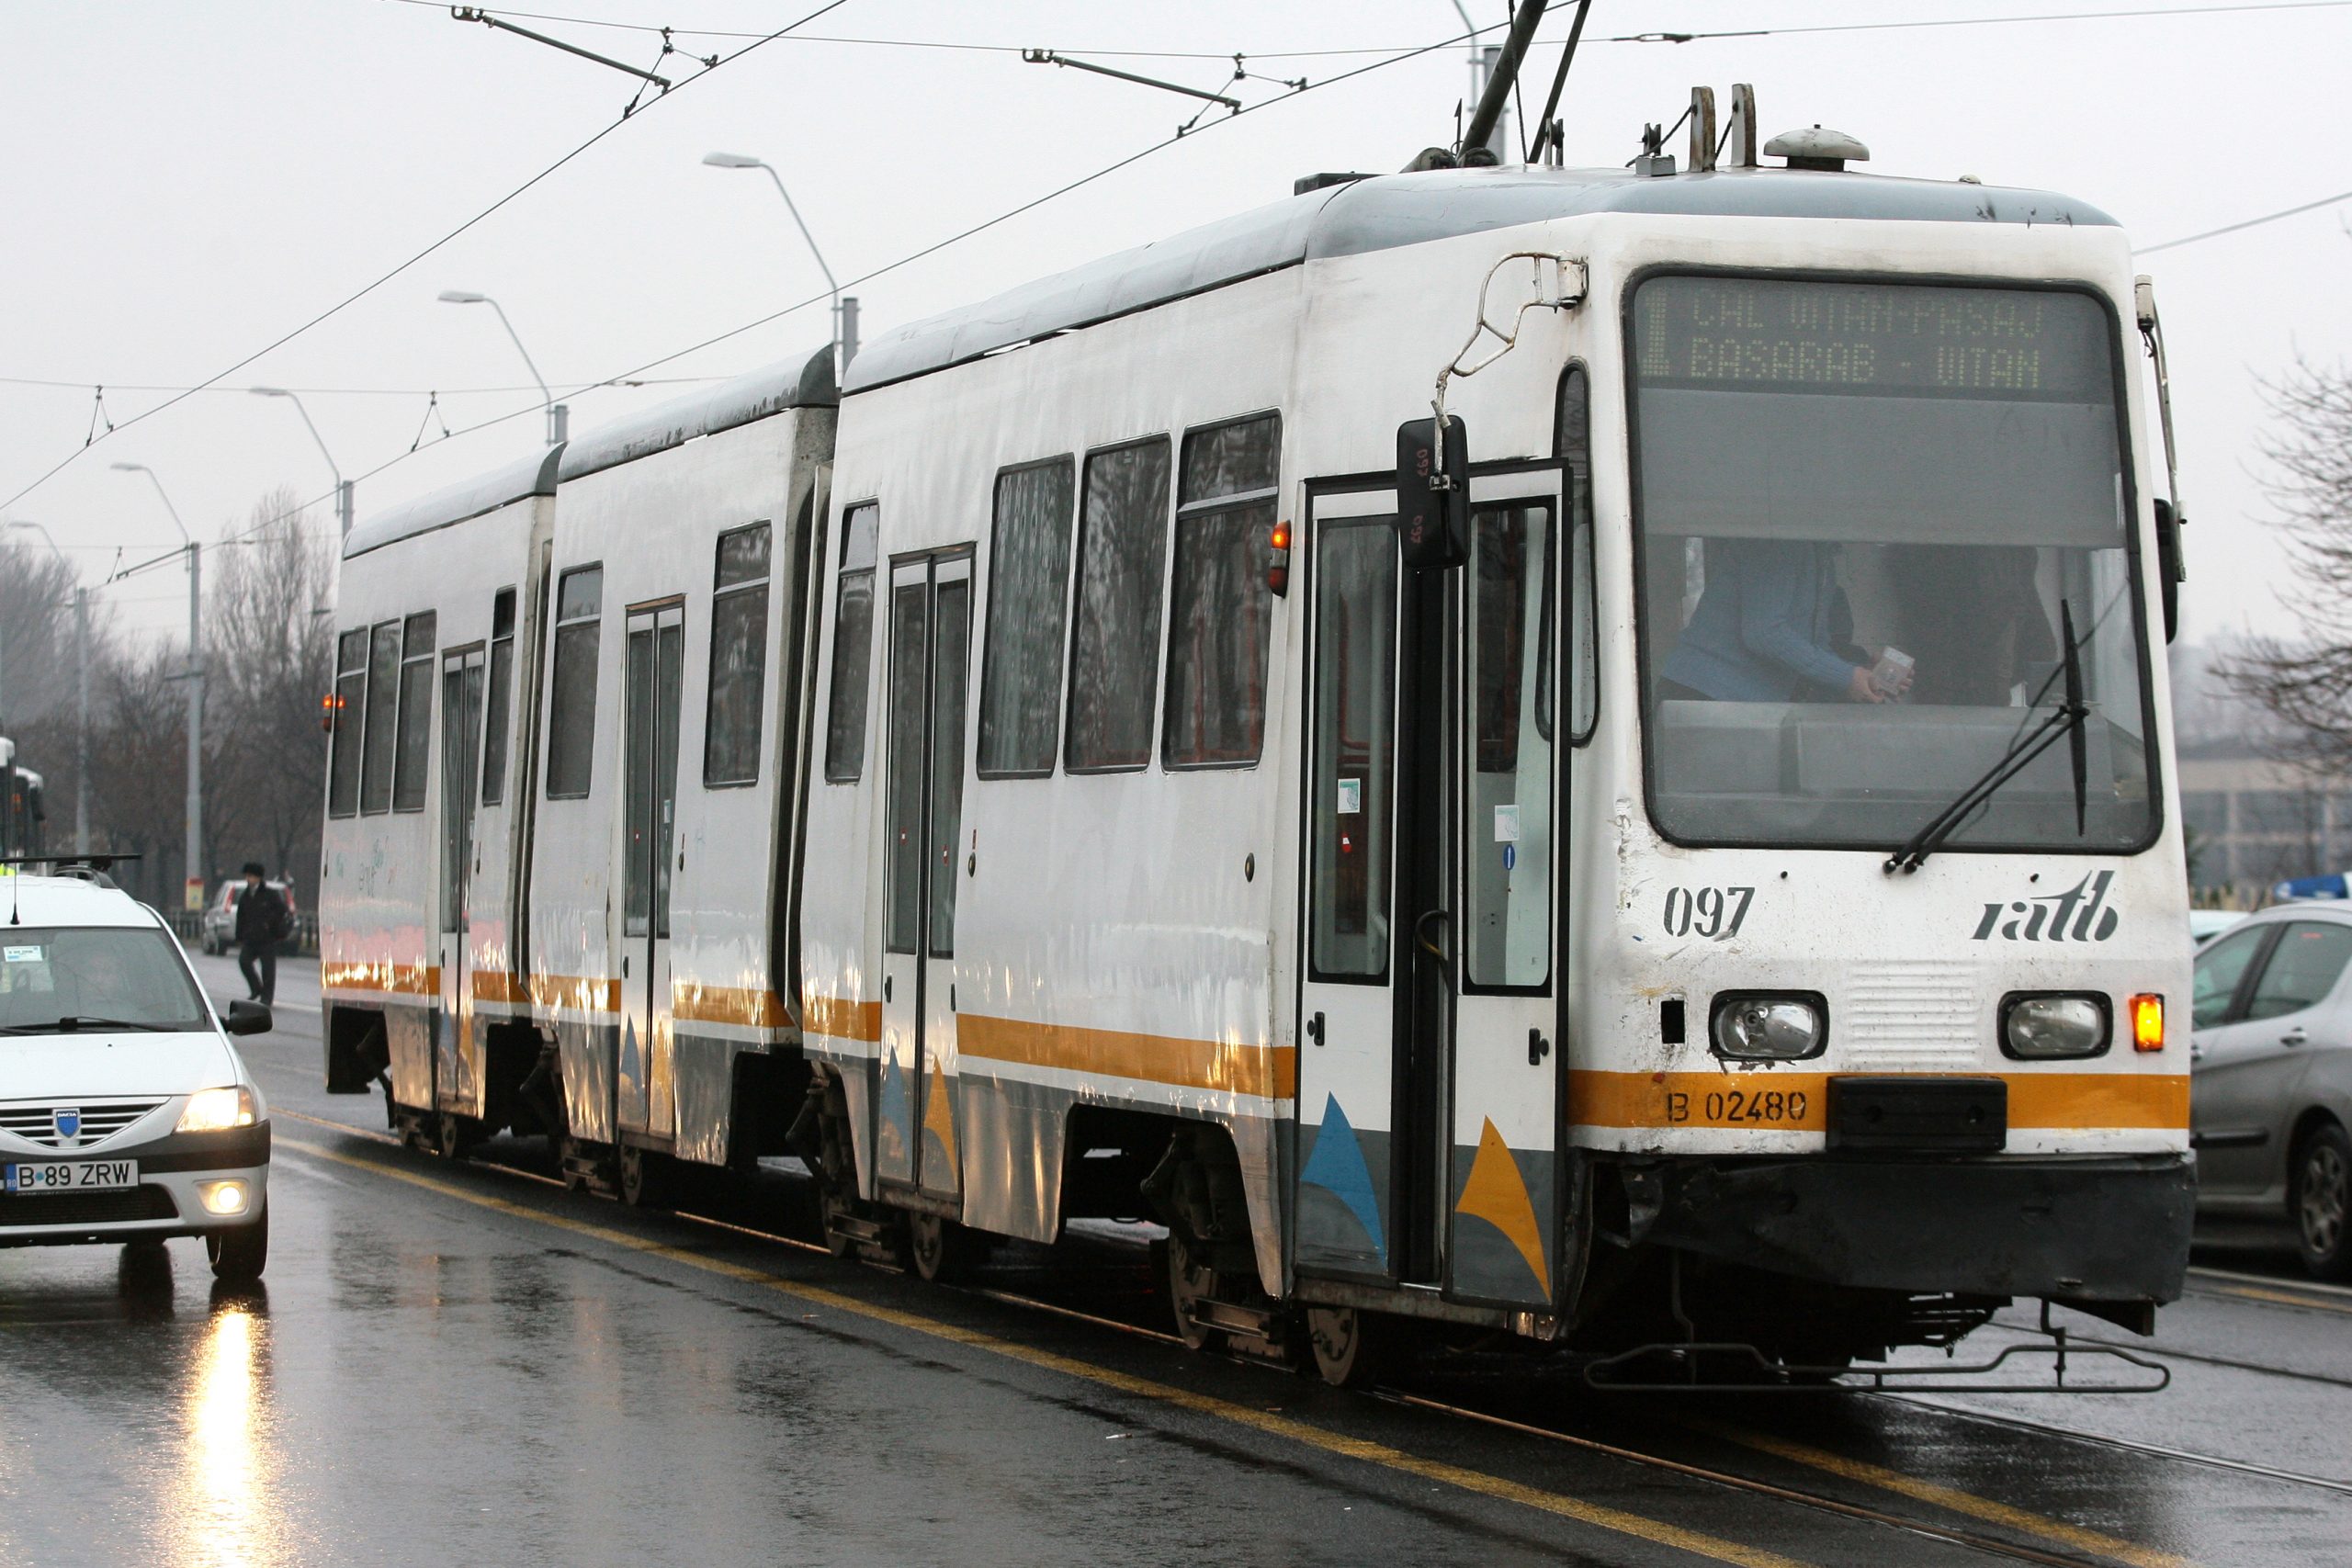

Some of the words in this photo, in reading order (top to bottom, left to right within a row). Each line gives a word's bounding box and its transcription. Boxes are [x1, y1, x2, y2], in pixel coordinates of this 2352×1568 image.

[1690, 336, 1875, 384] BASARAB
[1937, 345, 2040, 389] VITAN
[1664, 886, 1756, 939] 097
[1973, 870, 2119, 942] ratb
[1667, 1093, 1689, 1123] B
[1705, 1091, 1807, 1122] 02480
[6, 1179, 17, 1189] RO
[18, 1167, 35, 1189] B
[45, 1165, 72, 1187] 89
[79, 1163, 130, 1186] ZRW
